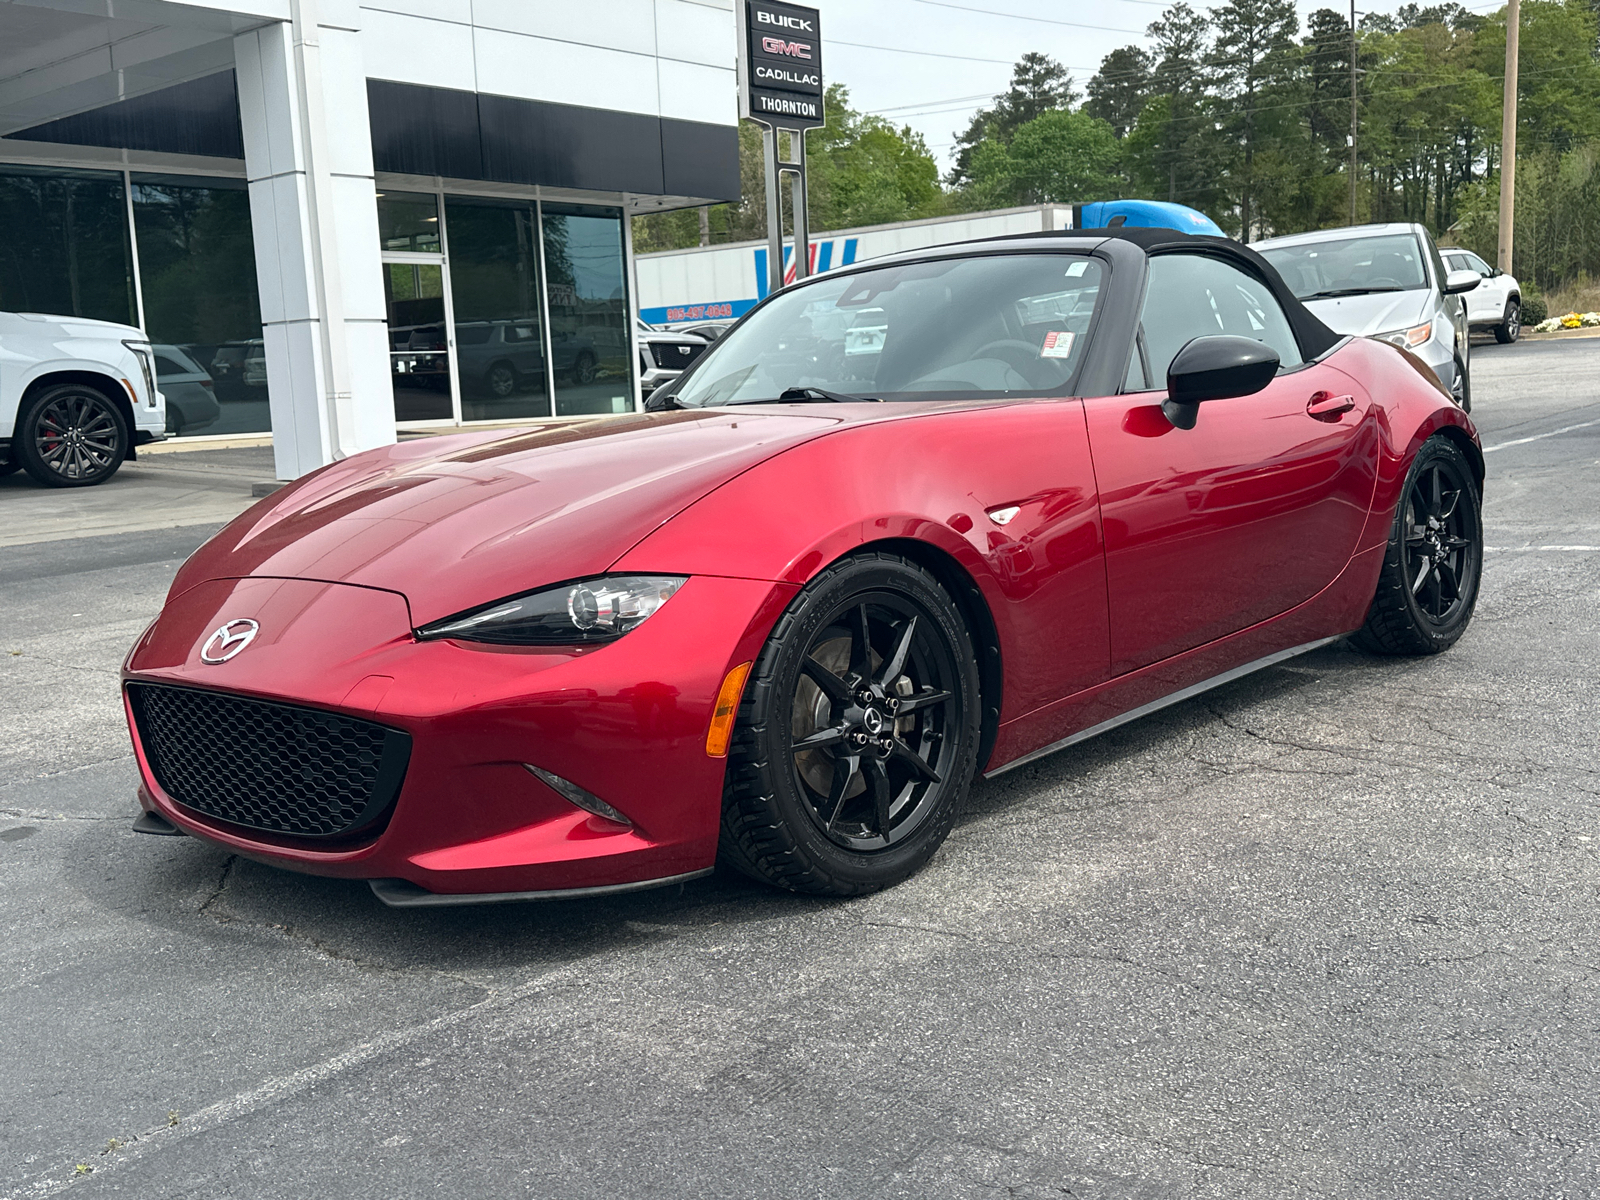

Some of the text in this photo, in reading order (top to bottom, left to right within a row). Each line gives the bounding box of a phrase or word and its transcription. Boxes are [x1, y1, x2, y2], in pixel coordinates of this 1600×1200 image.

[757, 11, 813, 31] BUICK
[762, 36, 811, 59] GMC
[757, 67, 819, 85] CADILLAC
[760, 96, 816, 116] THORNTON
[667, 303, 732, 321] 905-497-0848
